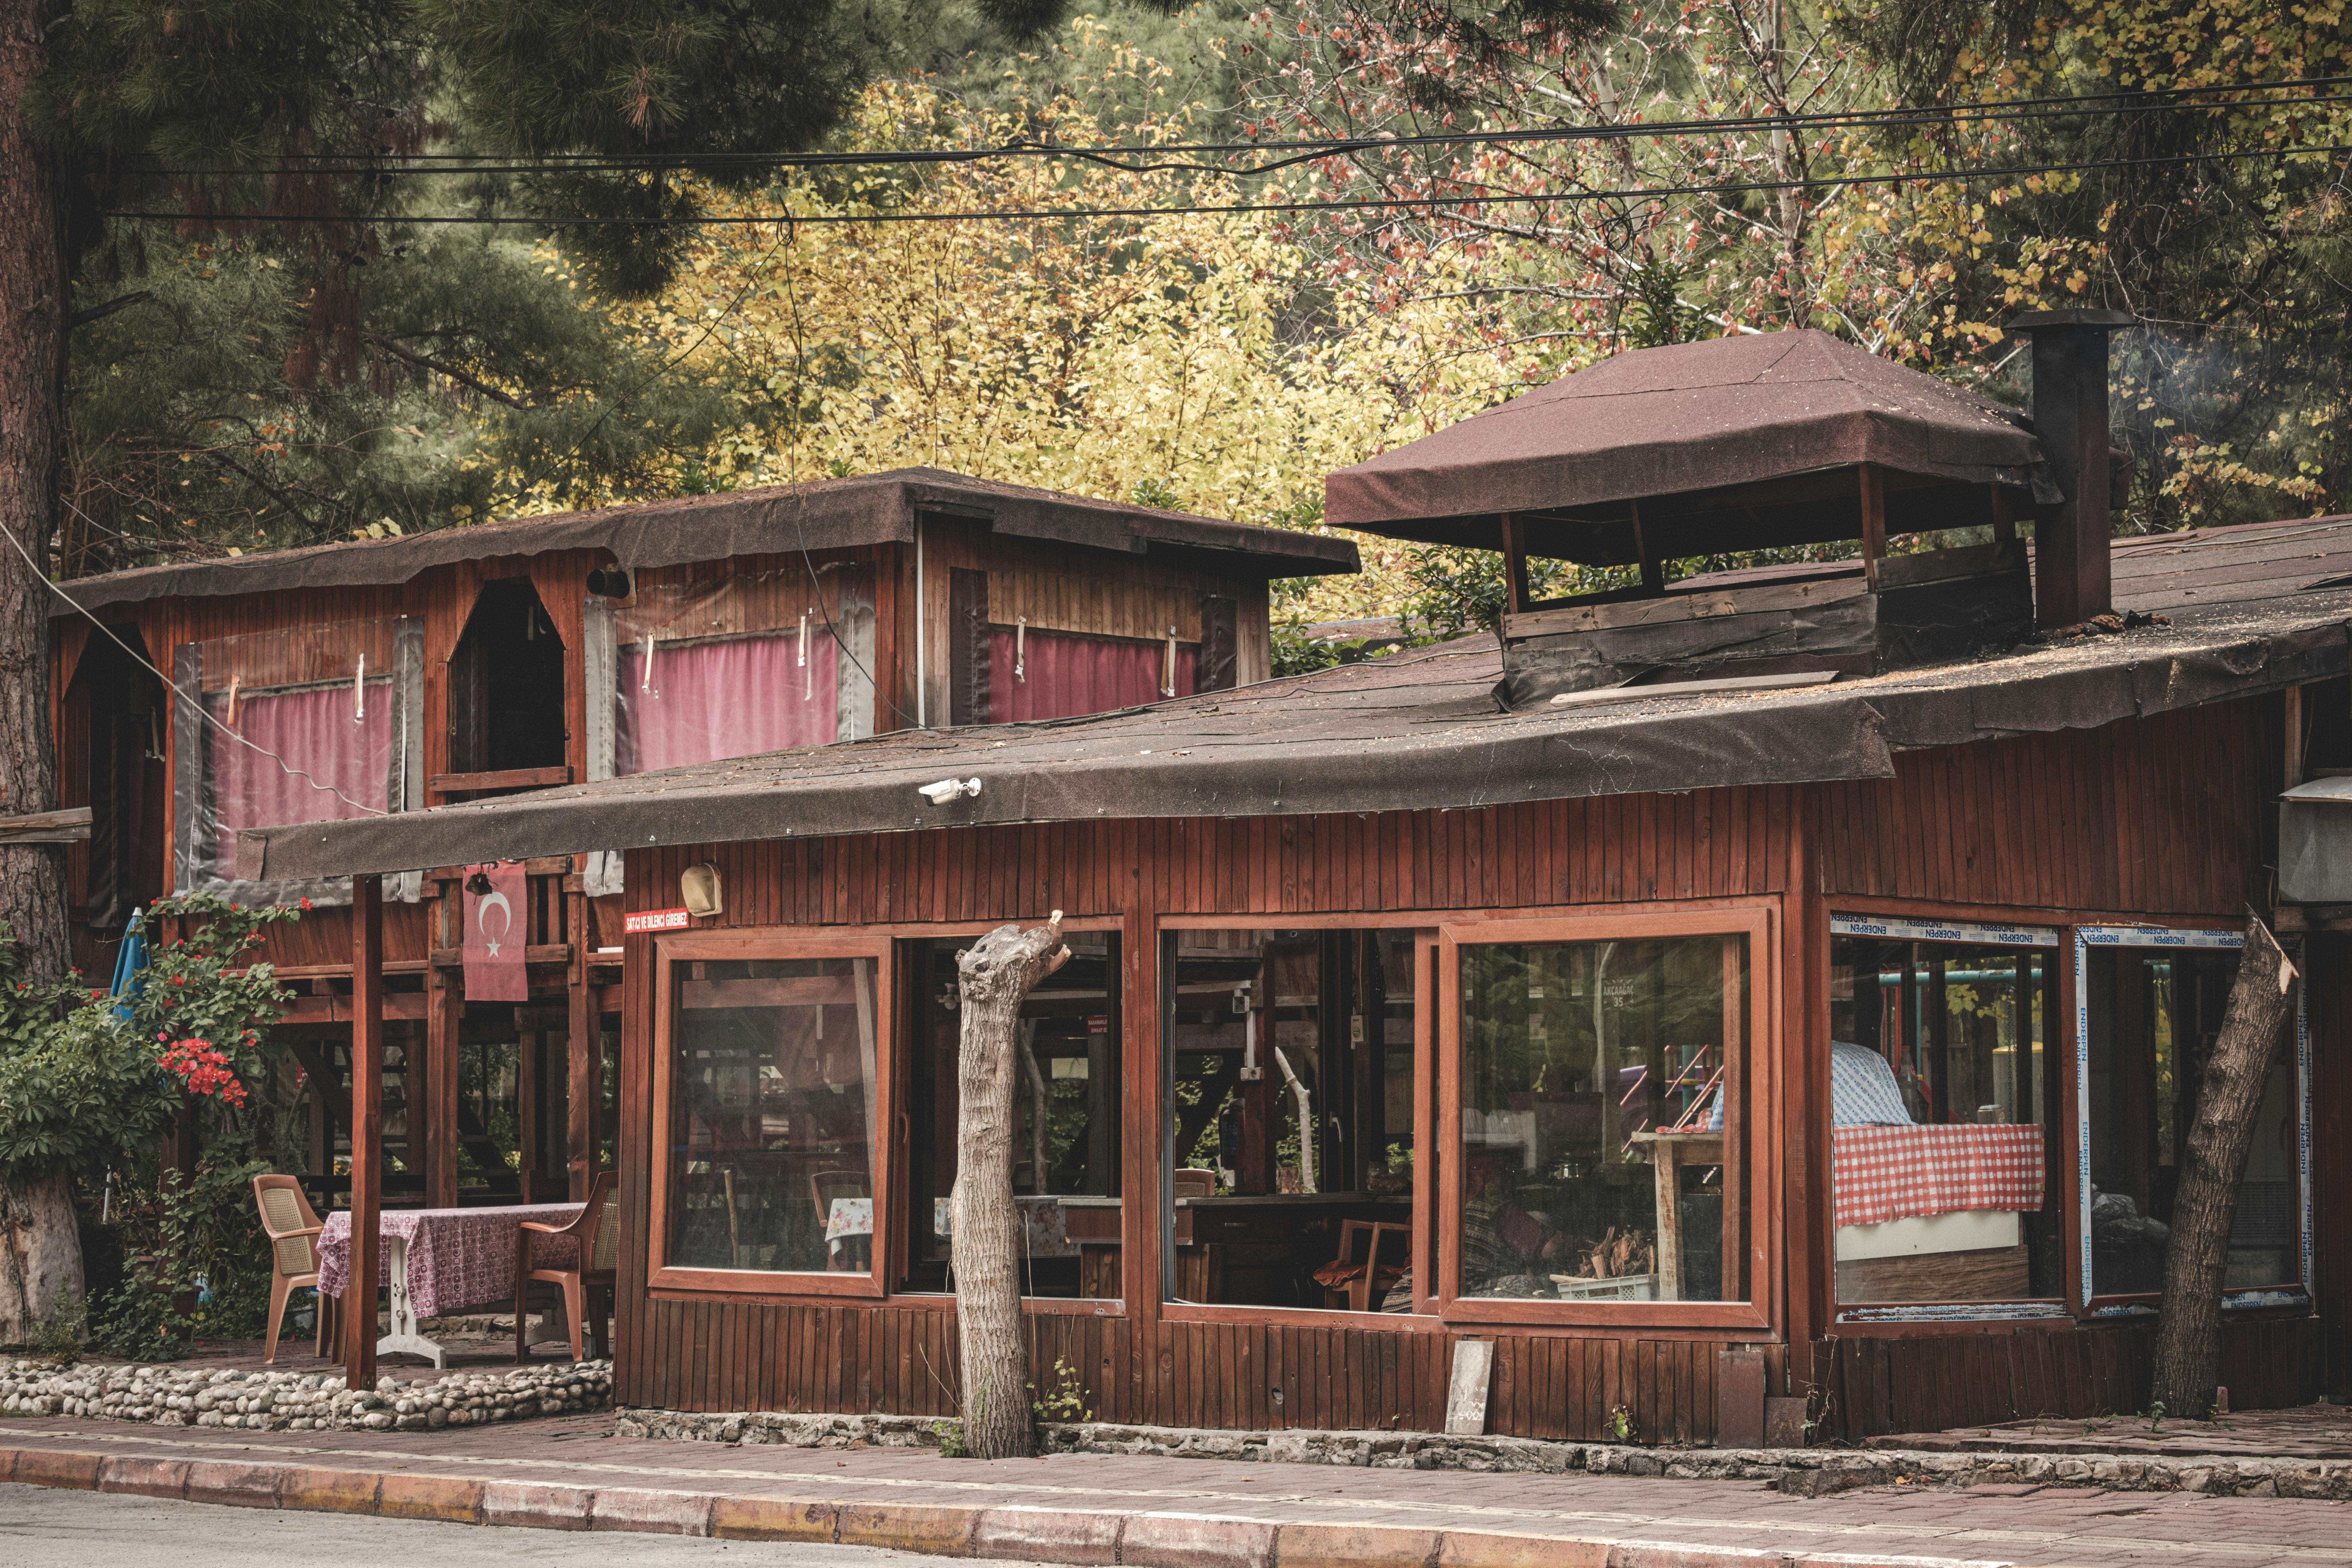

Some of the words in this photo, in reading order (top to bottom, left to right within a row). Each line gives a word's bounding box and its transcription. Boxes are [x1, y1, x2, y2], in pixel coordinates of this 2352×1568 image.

[627, 917, 640, 931] SATICI
[641, 916, 646, 929] VE
[647, 911, 665, 928] DİLENCİ
[666, 910, 687, 927] GİREMEZ
[1851, 924, 1886, 935] ENDERPEN
[1926, 929, 1960, 939] ENDERPEN
[1999, 933, 2033, 943] ENDERPEN
[2087, 935, 2119, 943] ENDERPEN
[2154, 936, 2185, 945] ENDERPEN
[1604, 984, 1634, 998] AKÇAAĞAÇ
[1614, 997, 1623, 1007] 35
